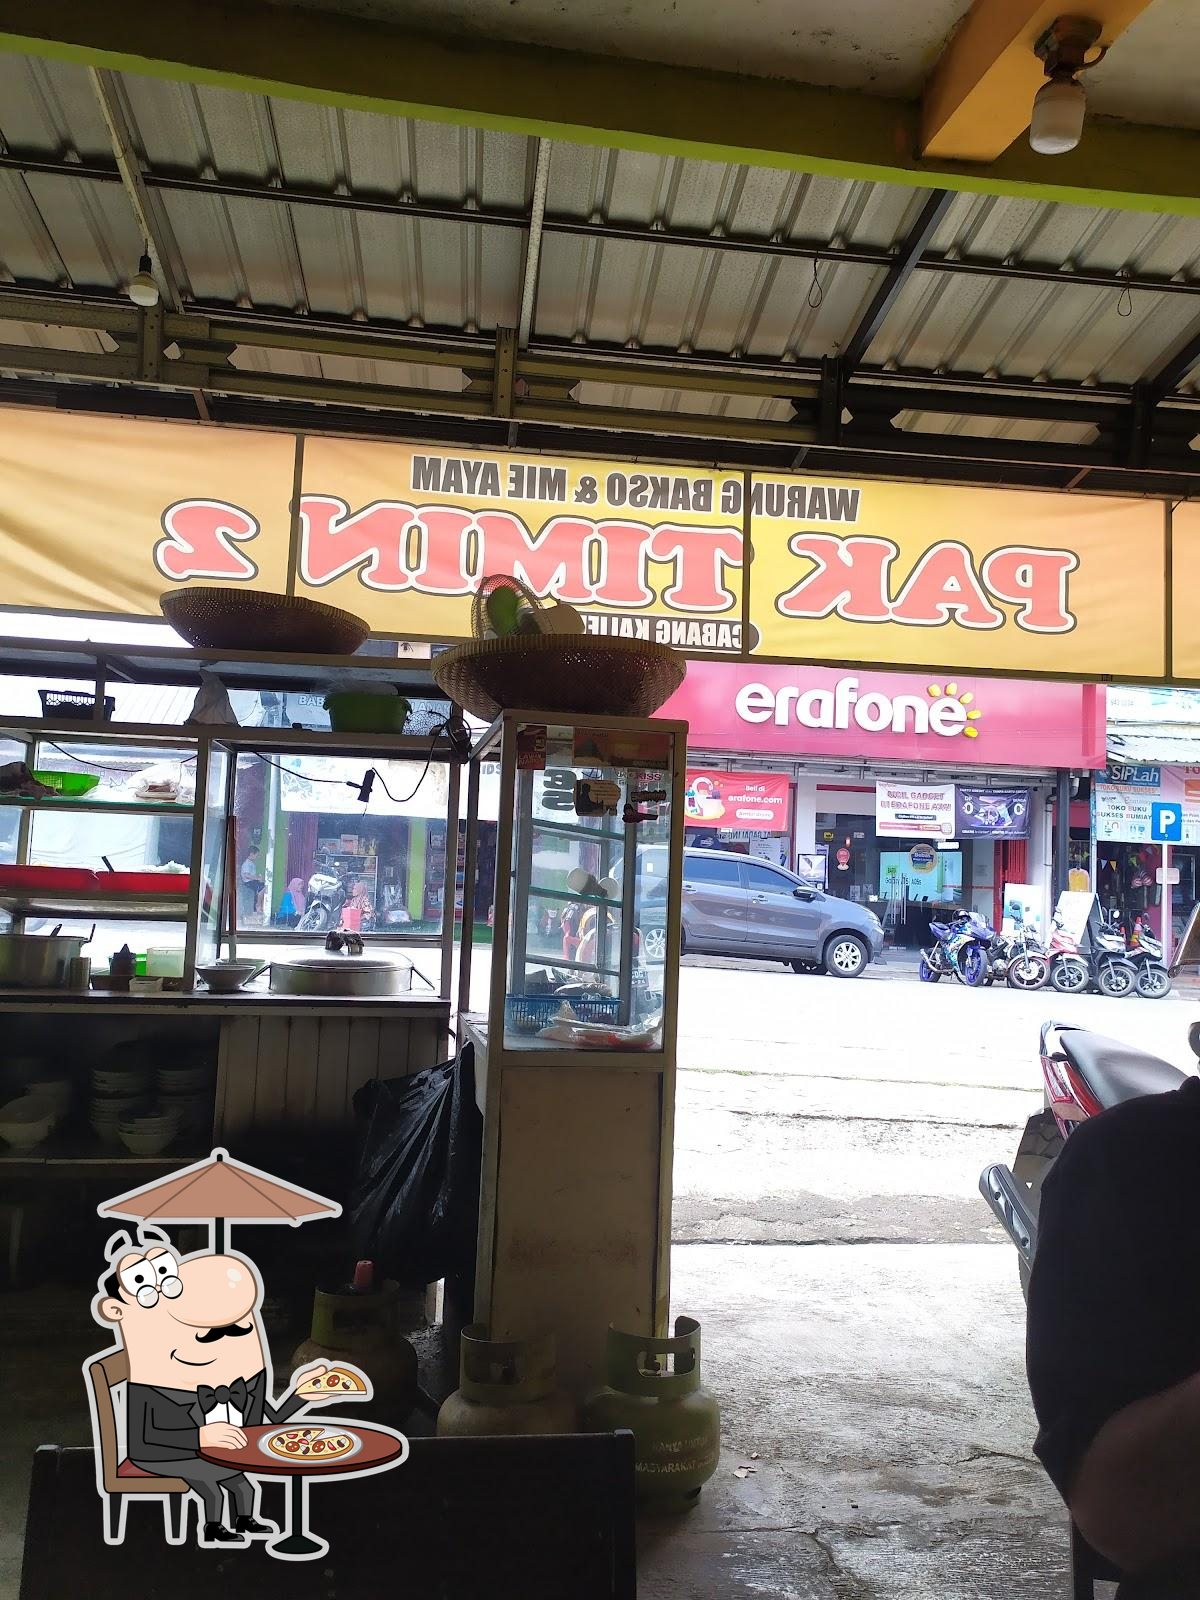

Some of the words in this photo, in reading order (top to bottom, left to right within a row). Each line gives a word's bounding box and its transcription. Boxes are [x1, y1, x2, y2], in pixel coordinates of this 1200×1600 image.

[735, 676, 968, 737] erafone
[1111, 765, 1159, 782] SIPLah
[728, 794, 783, 804] erafone.com
[1160, 810, 1176, 833] P
